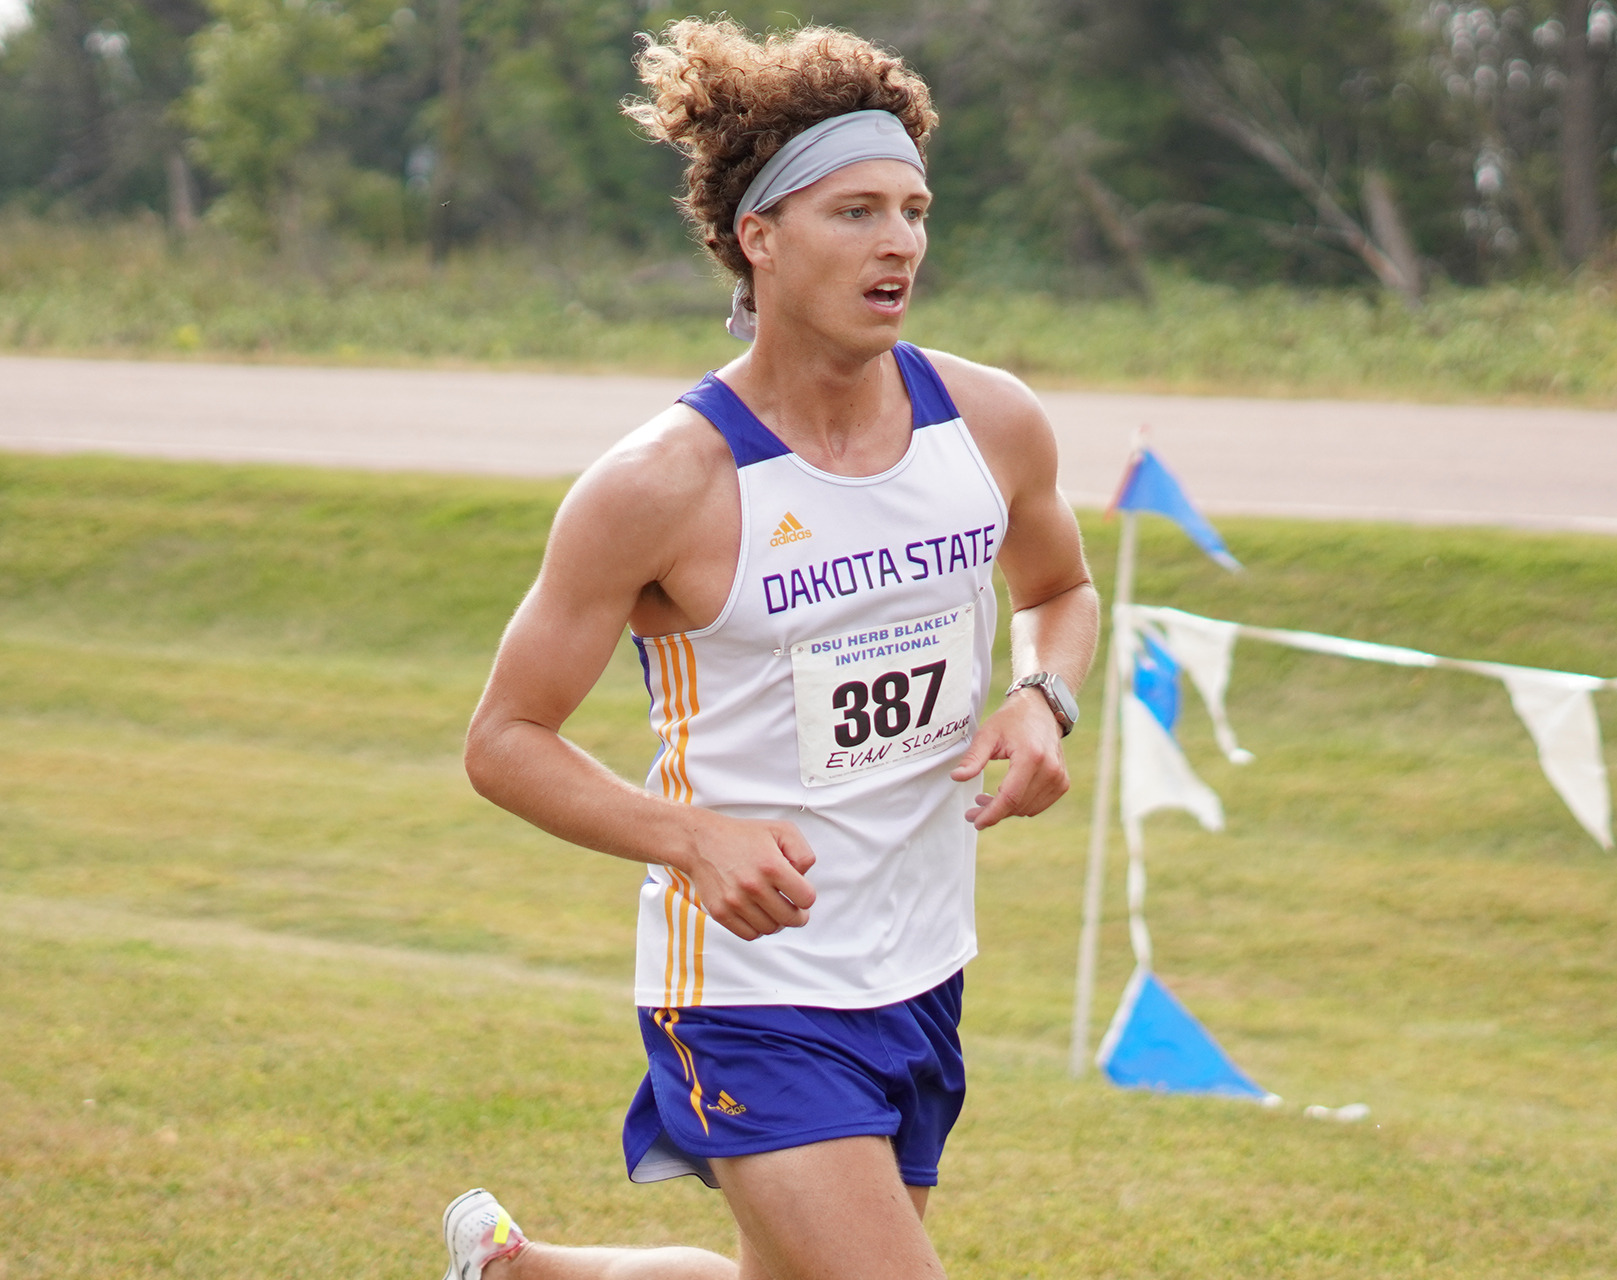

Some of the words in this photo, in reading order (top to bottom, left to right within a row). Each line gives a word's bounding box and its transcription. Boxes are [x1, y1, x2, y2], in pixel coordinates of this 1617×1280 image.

[770, 529, 812, 547] adidas
[763, 548, 902, 614] DAKOTA
[905, 524, 995, 580] STATE
[811, 638, 842, 654] DSU
[847, 629, 889, 647] HERB
[894, 612, 959, 637] BLAKELY
[835, 634, 940, 666] INVITATIONAL
[832, 658, 946, 748] 387
[826, 742, 893, 768] EVAN
